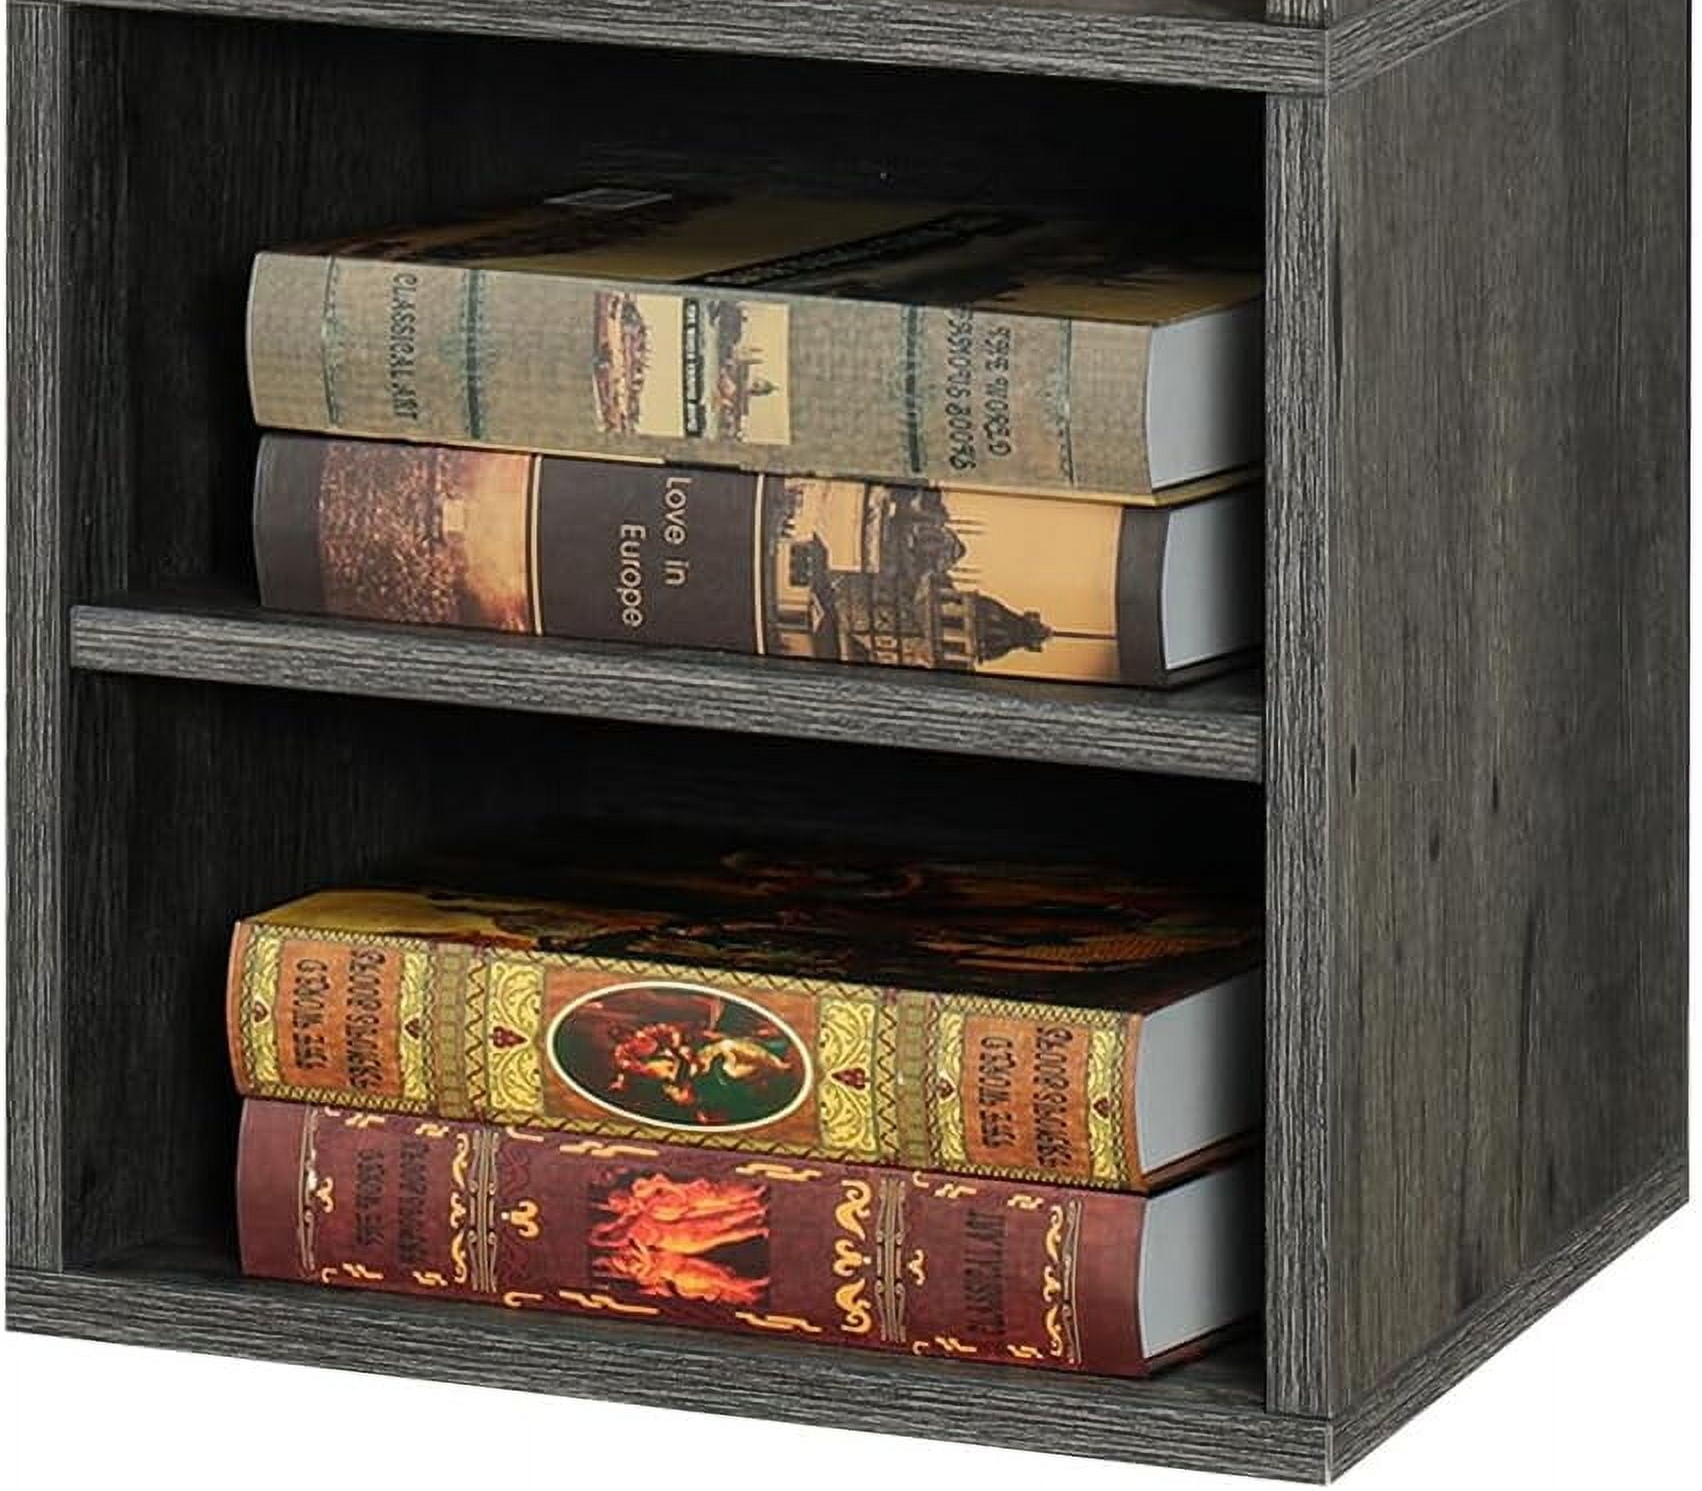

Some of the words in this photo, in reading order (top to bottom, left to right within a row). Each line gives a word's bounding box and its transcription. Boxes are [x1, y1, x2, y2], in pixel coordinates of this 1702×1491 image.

[389, 272, 418, 380] CLASSICAL
[662, 475, 693, 546] Love
[617, 523, 647, 628] Europe
[664, 562, 692, 587] in
